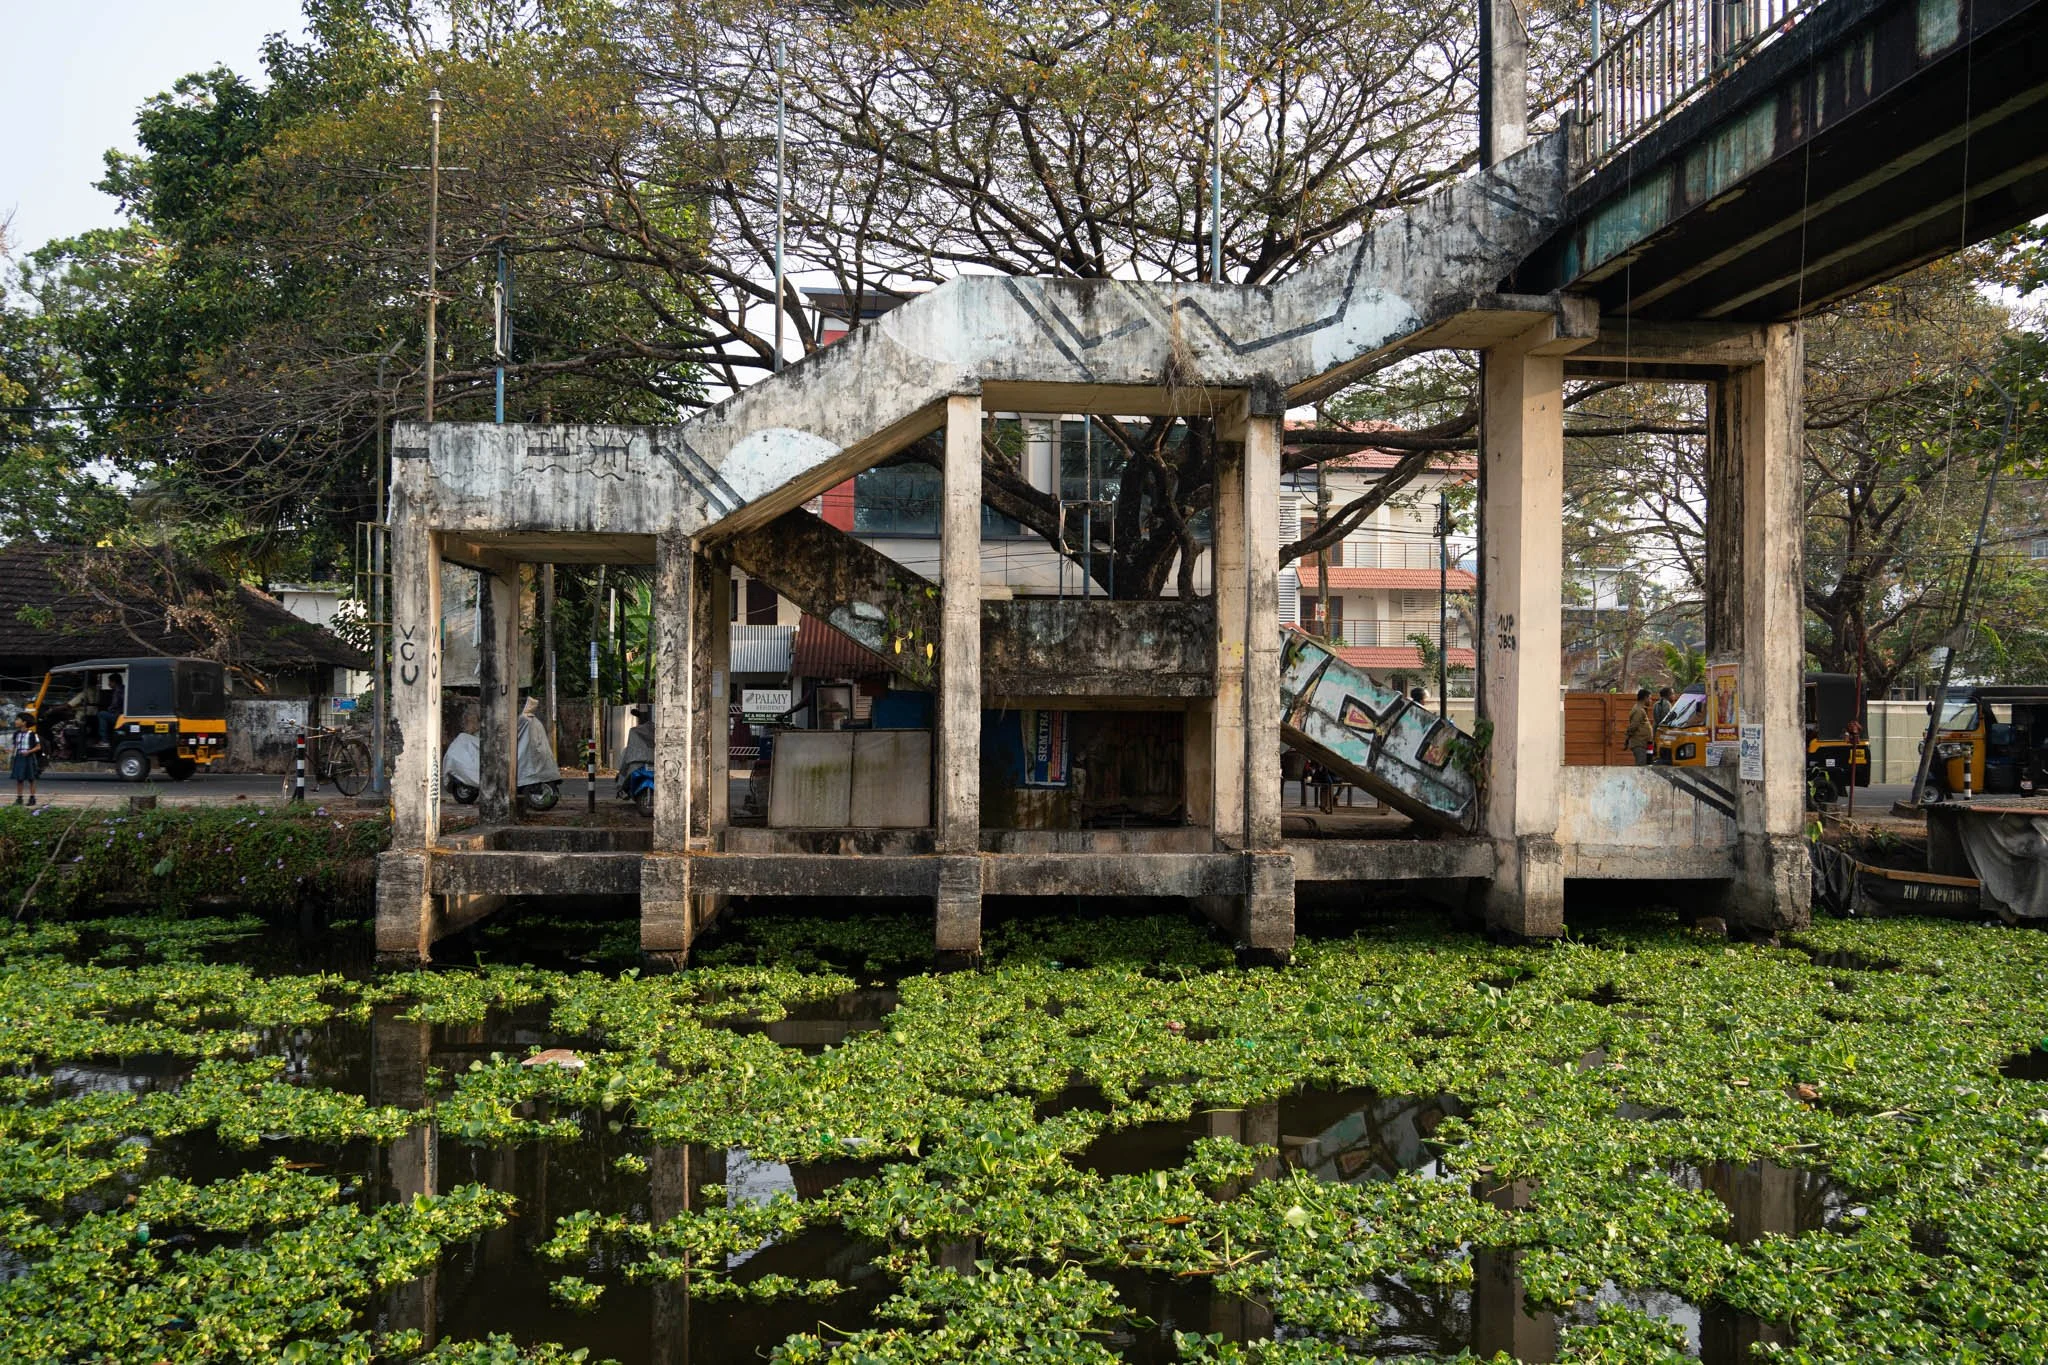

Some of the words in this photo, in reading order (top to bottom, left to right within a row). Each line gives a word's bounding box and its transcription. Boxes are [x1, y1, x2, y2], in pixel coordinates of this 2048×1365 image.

[399, 624, 419, 686] VCU
[755, 693, 788, 705] PALMY
[1038, 735, 1048, 761] SRM
